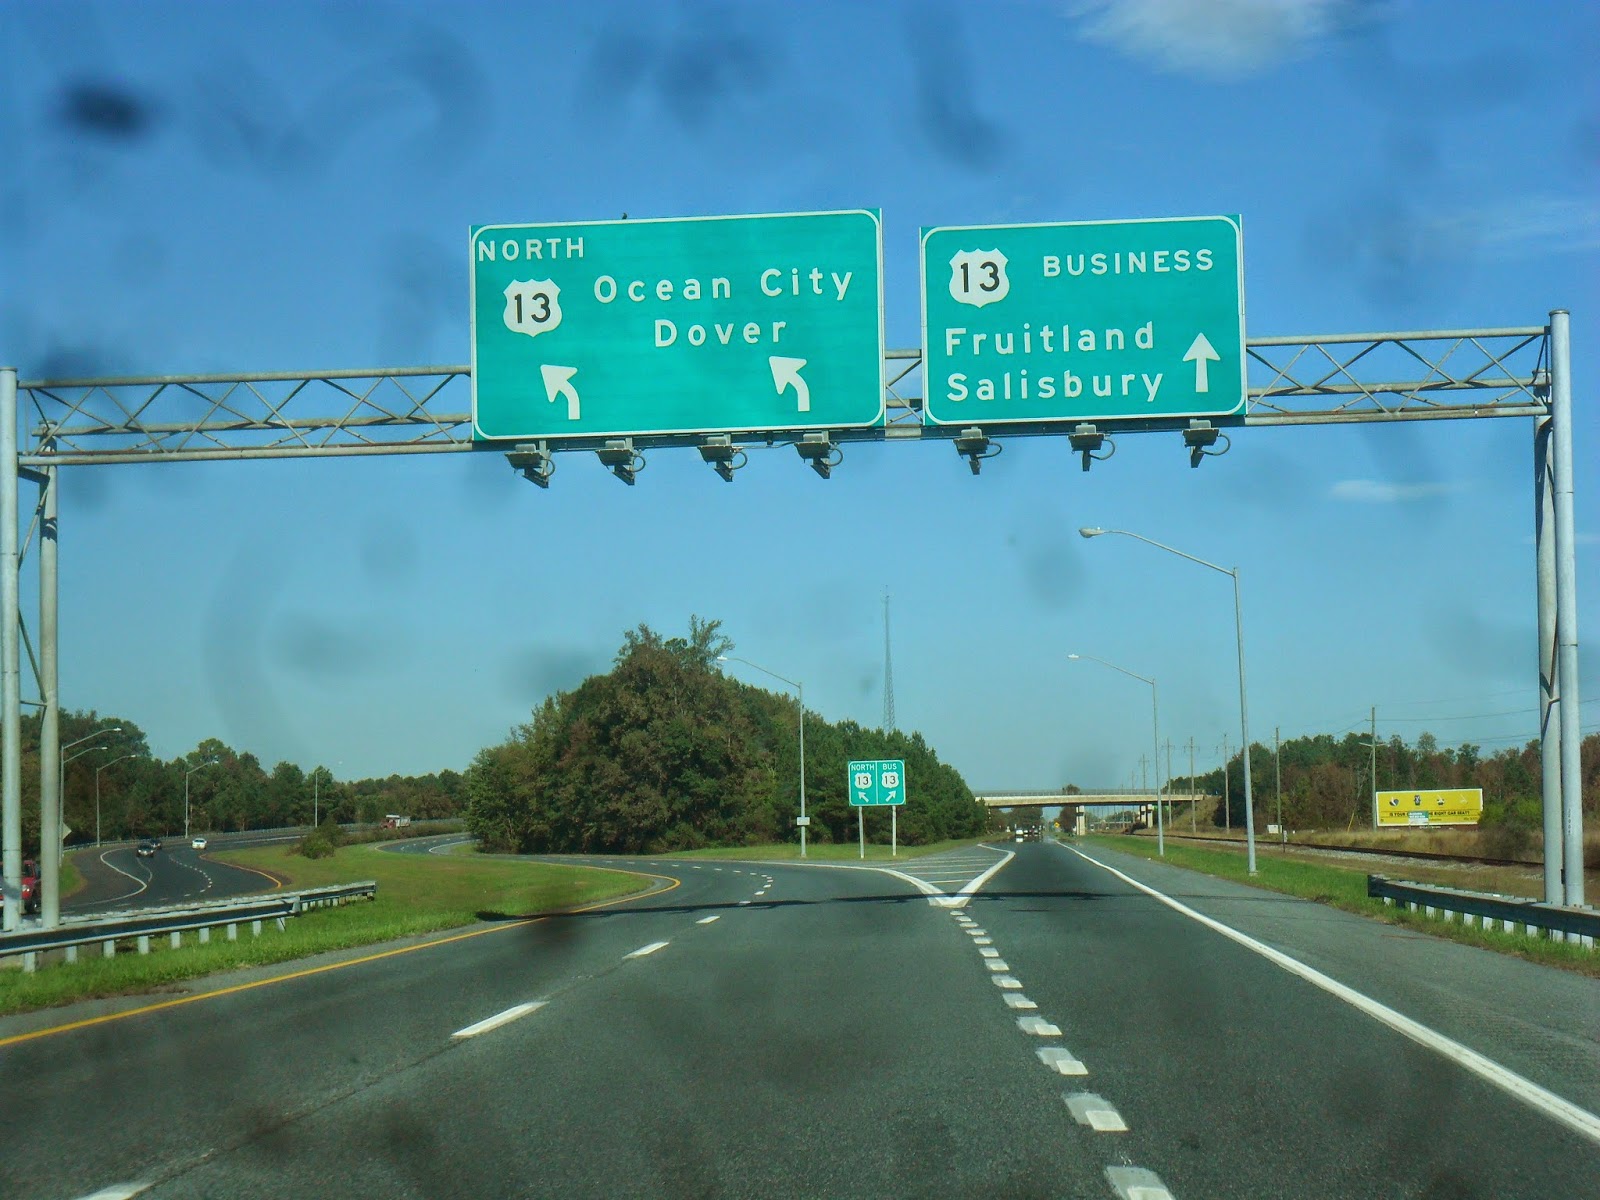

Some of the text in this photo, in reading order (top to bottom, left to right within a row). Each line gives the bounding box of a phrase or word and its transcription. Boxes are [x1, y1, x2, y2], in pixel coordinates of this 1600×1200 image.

[478, 237, 584, 262] NORTH
[1043, 249, 1213, 277] BUSINESS
[594, 268, 853, 303] Ocean City
[960, 261, 1000, 293] 13
[514, 293, 551, 323] 13
[655, 320, 786, 347] Dover
[946, 321, 1154, 356] Fruitland
[947, 369, 1163, 402] Salisbury
[851, 763, 875, 771] NORTH
[858, 776, 869, 785] 13
[884, 775, 896, 785] 13
